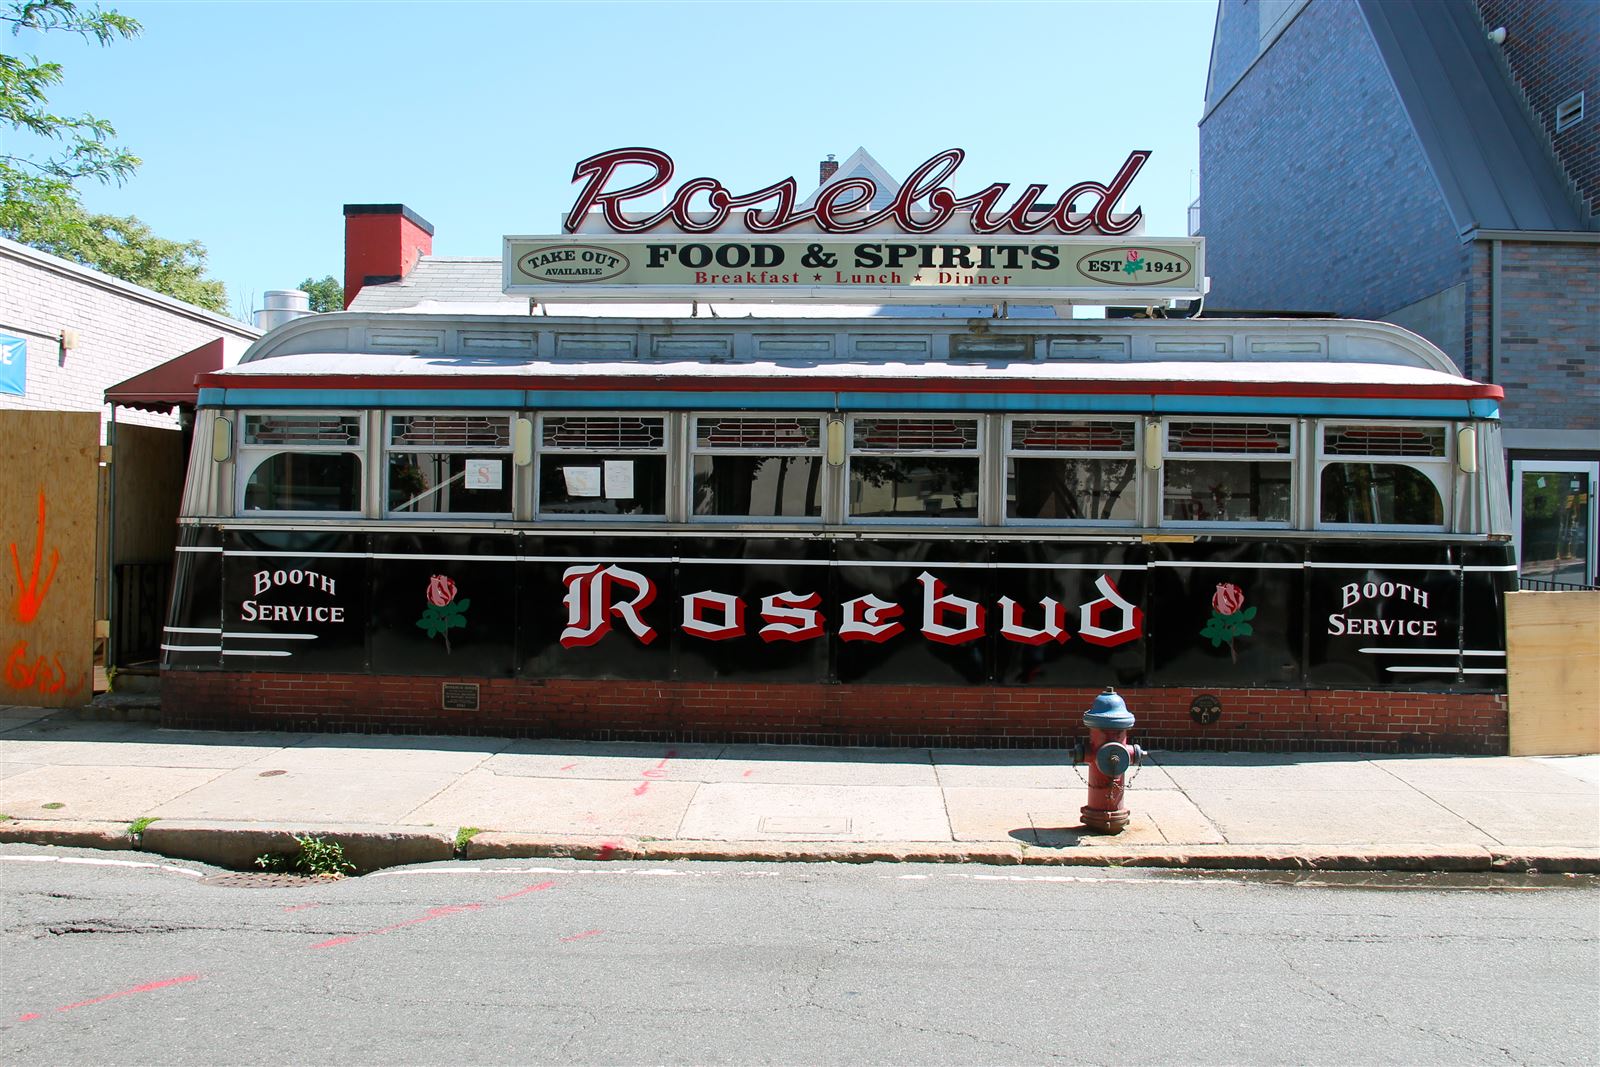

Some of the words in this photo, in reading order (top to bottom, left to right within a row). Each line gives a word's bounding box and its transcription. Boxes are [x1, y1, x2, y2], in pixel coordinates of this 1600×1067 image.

[563, 146, 1153, 235] Rosebud
[528, 250, 576, 269] TAKE
[581, 250, 620, 269] OUT
[645, 244, 786, 269] FOOD
[800, 243, 839, 269] &
[854, 243, 1061, 271] SPIRITS
[1087, 260, 1122, 273] EST
[1144, 261, 1183, 273] 1941
[545, 268, 603, 276] AVAILABLE
[694, 271, 800, 284] Breakfast
[835, 272, 902, 285] Lunch
[938, 273, 1012, 286] Dinner
[559, 563, 1143, 648] Rosebud
